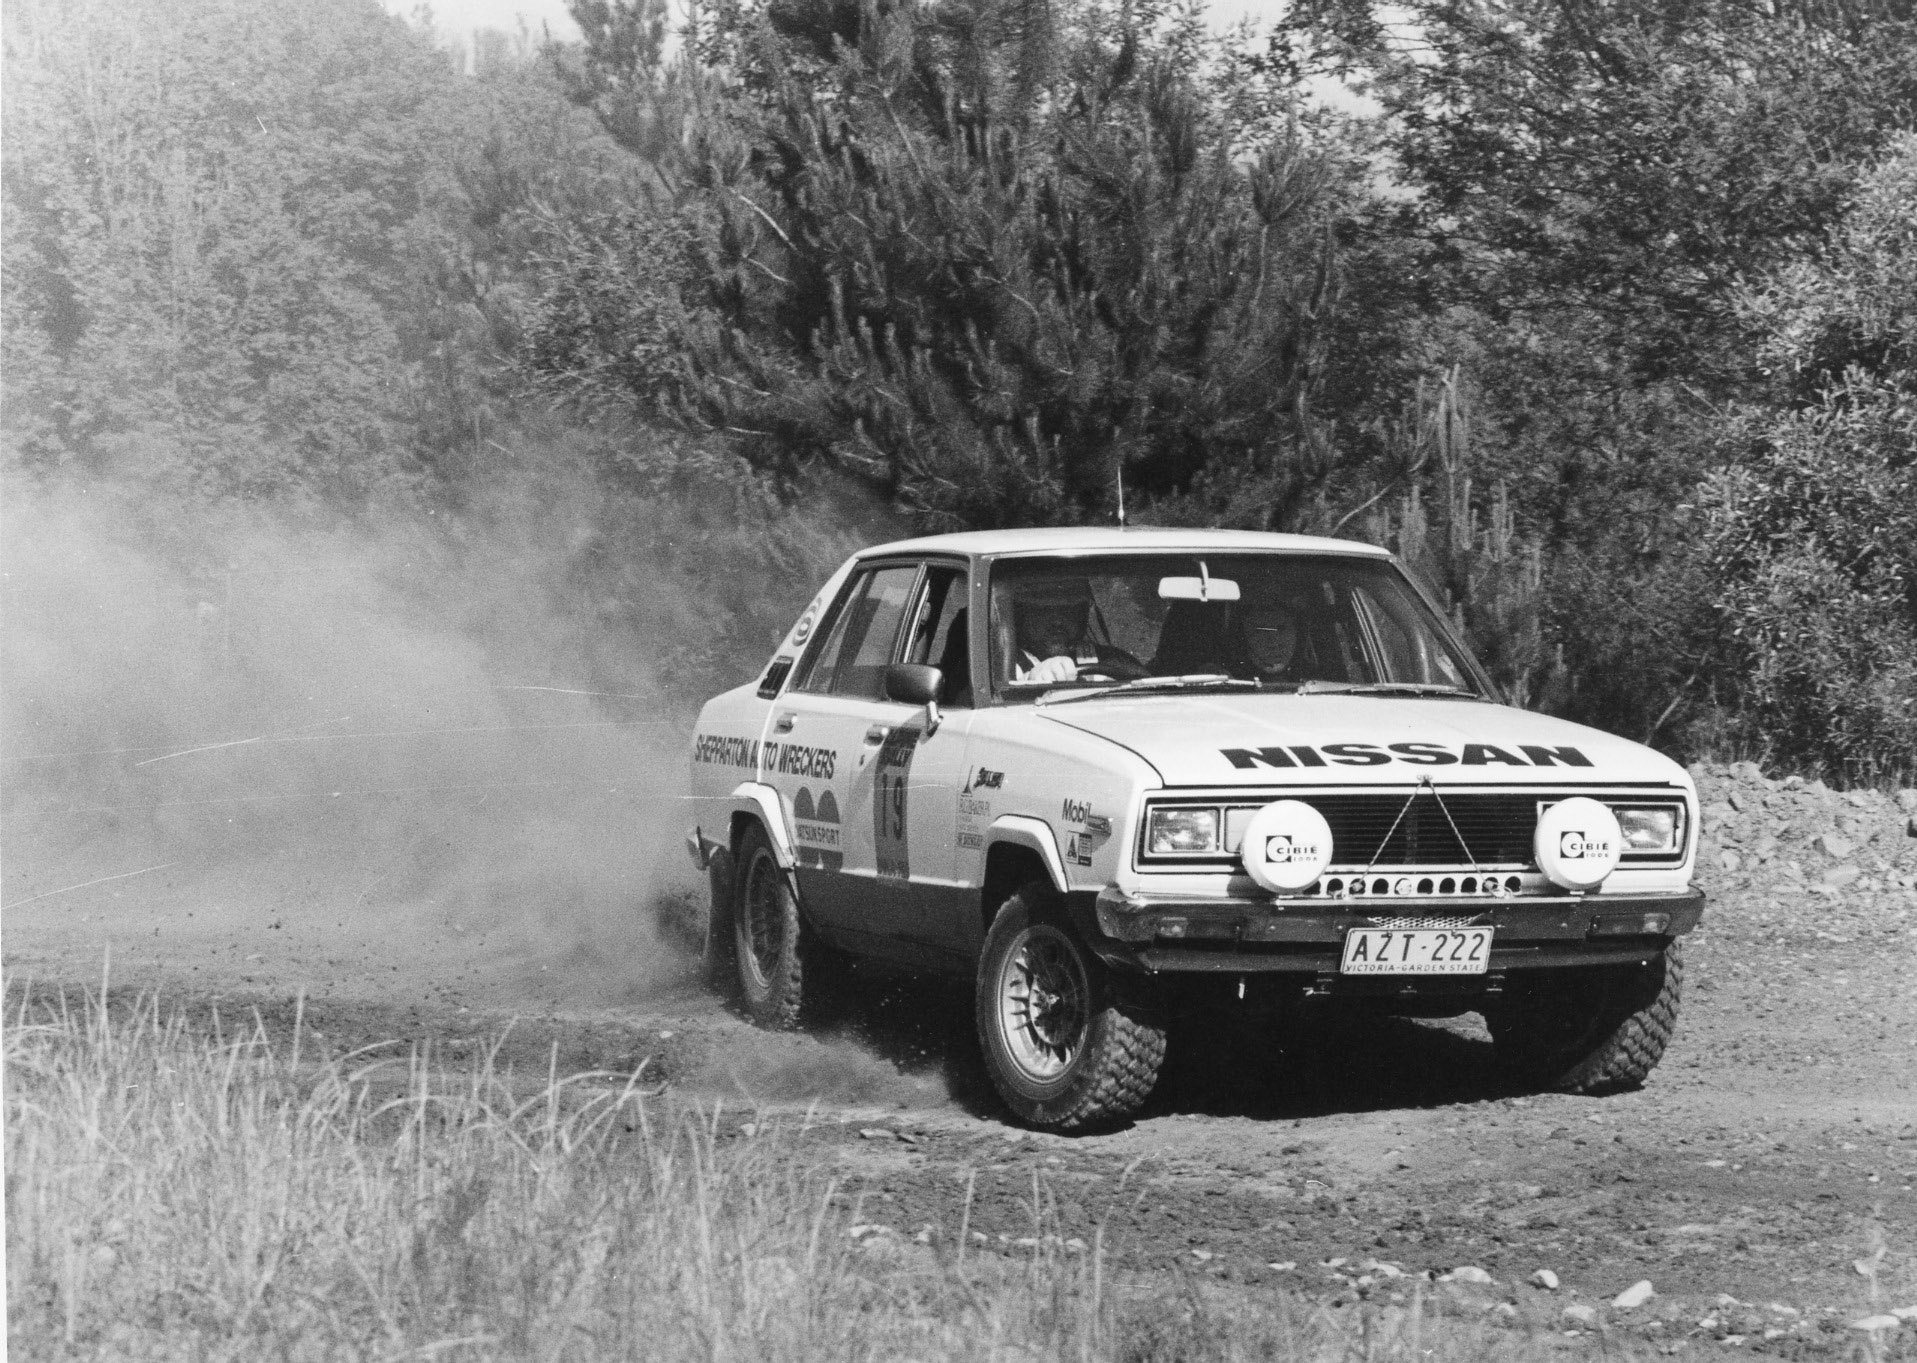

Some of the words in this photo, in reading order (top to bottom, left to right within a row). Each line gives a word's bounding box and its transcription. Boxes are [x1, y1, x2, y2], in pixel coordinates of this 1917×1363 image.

[695, 734, 751, 767] SHEPPARTON
[750, 740, 778, 770] ATO
[778, 743, 837, 779] WRECKERS
[1219, 742, 1595, 769] NISSAN
[1061, 797, 1092, 824] Mobil
[1351, 933, 1485, 962] AZT-222
